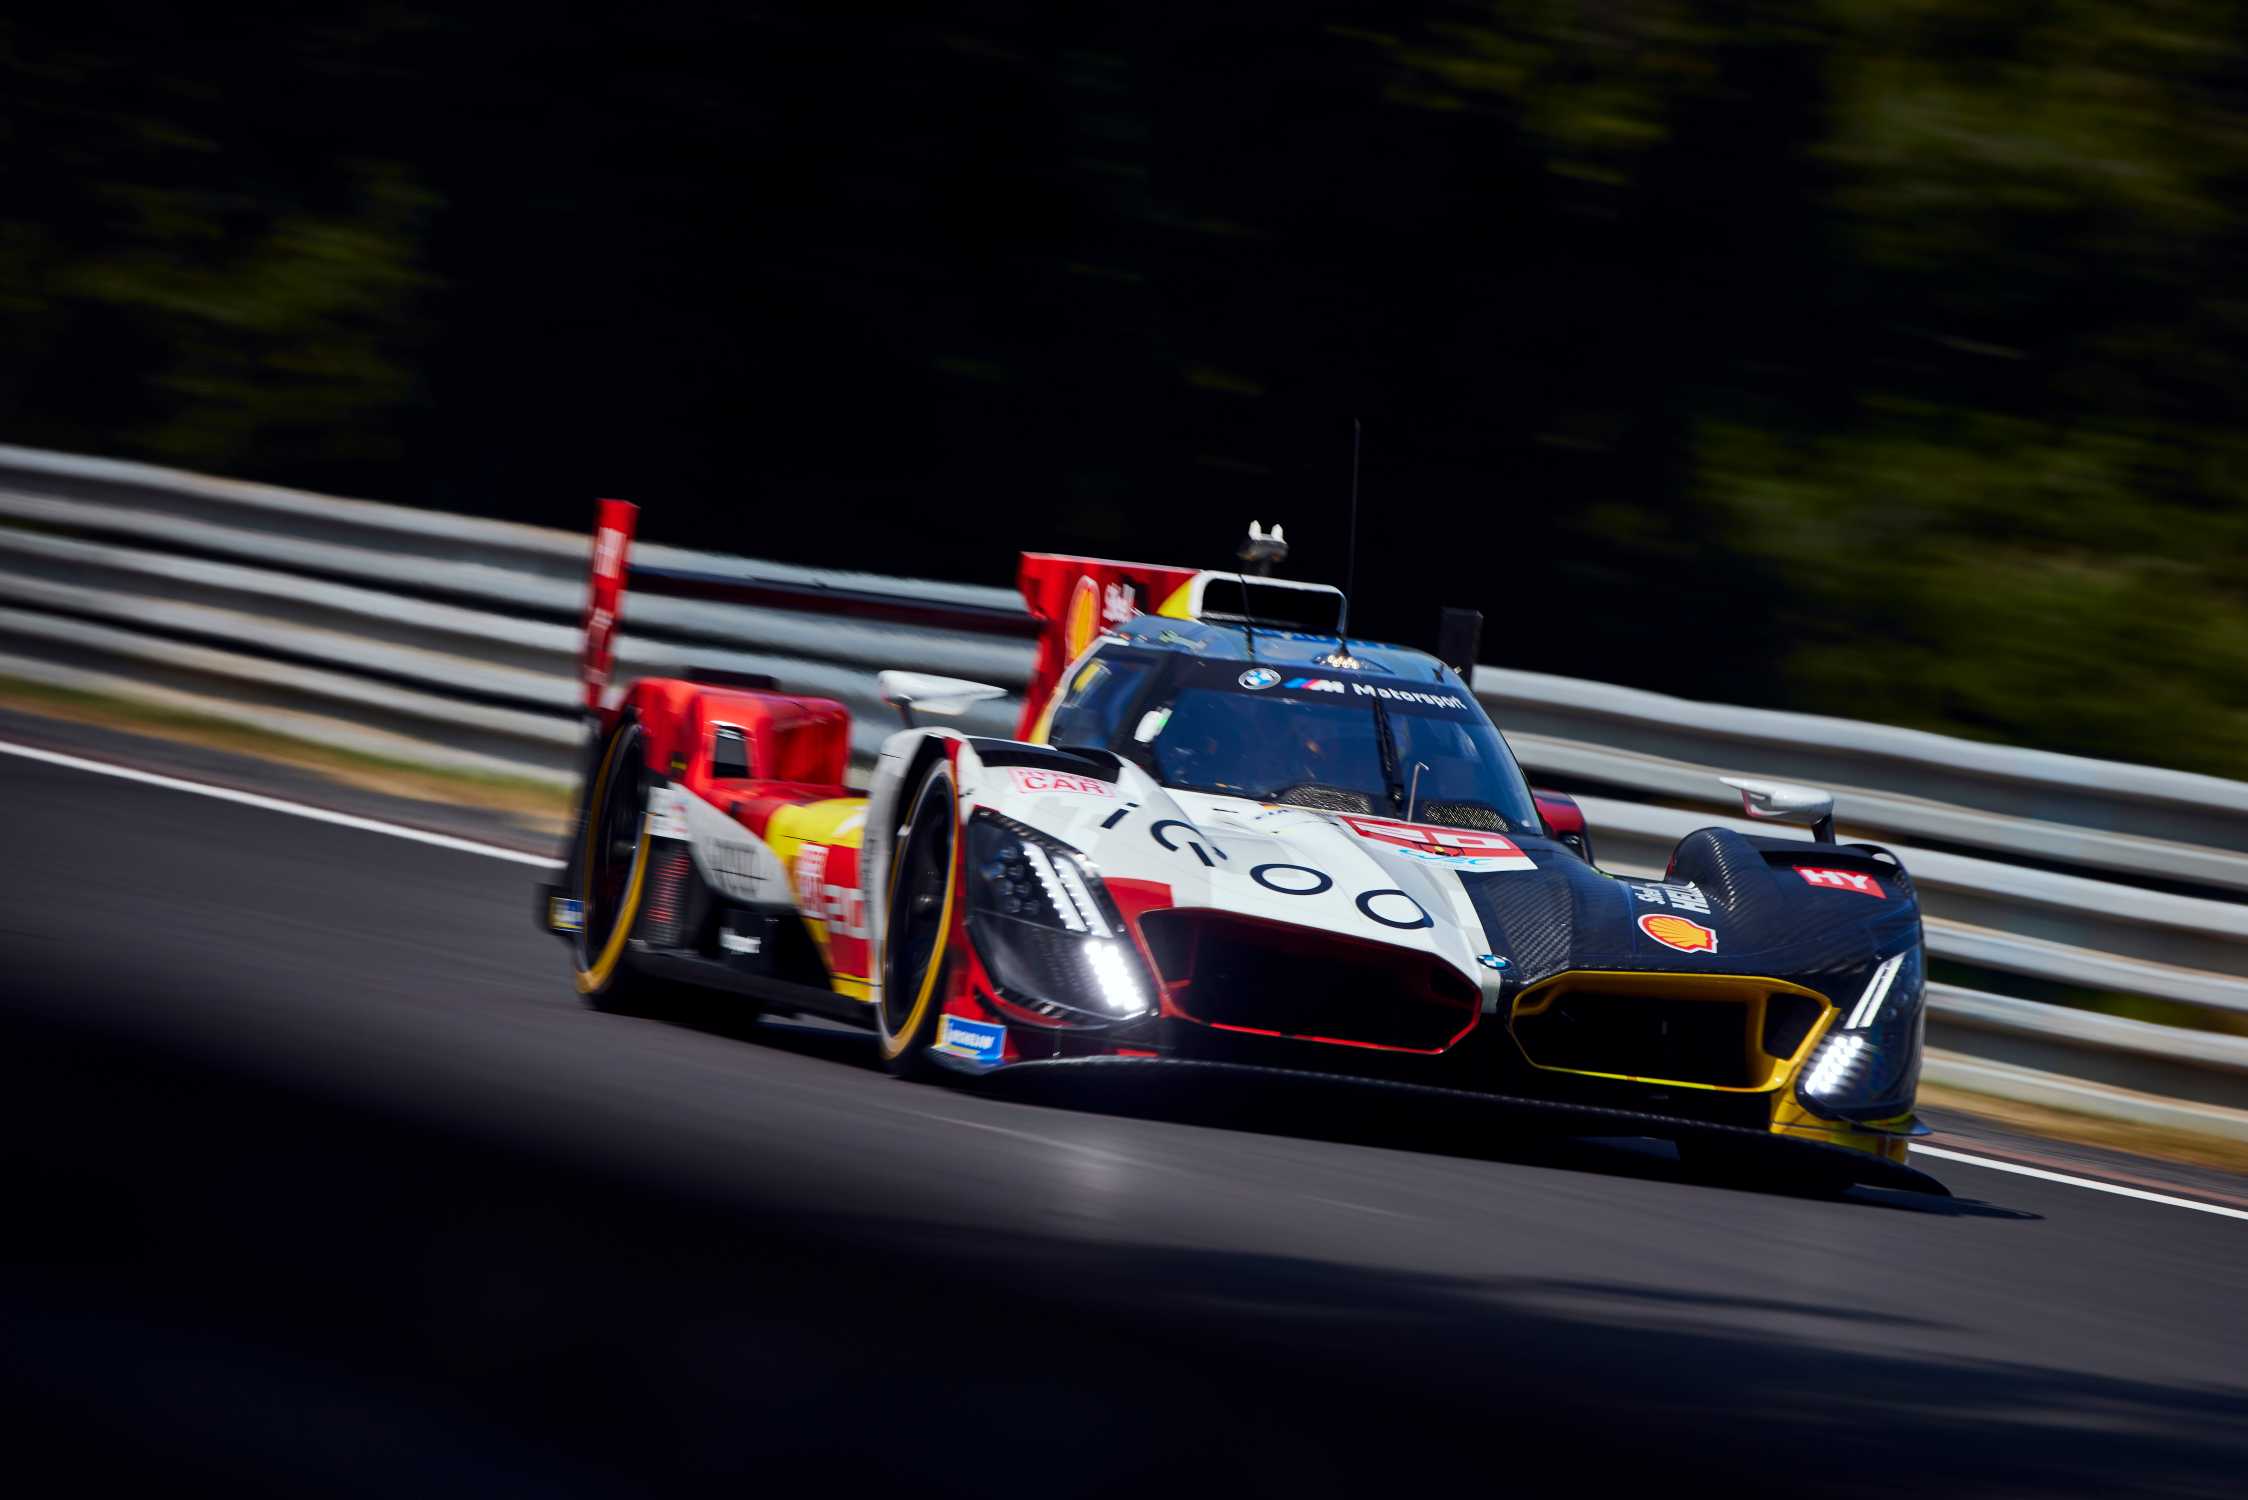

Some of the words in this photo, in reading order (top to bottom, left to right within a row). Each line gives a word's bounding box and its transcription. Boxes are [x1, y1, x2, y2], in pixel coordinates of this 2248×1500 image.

[1351, 683, 1468, 711] Motorsport
[1024, 776, 1105, 795] CAR
[1101, 802, 1435, 930] iQOO
[1800, 869, 1869, 890] HY
